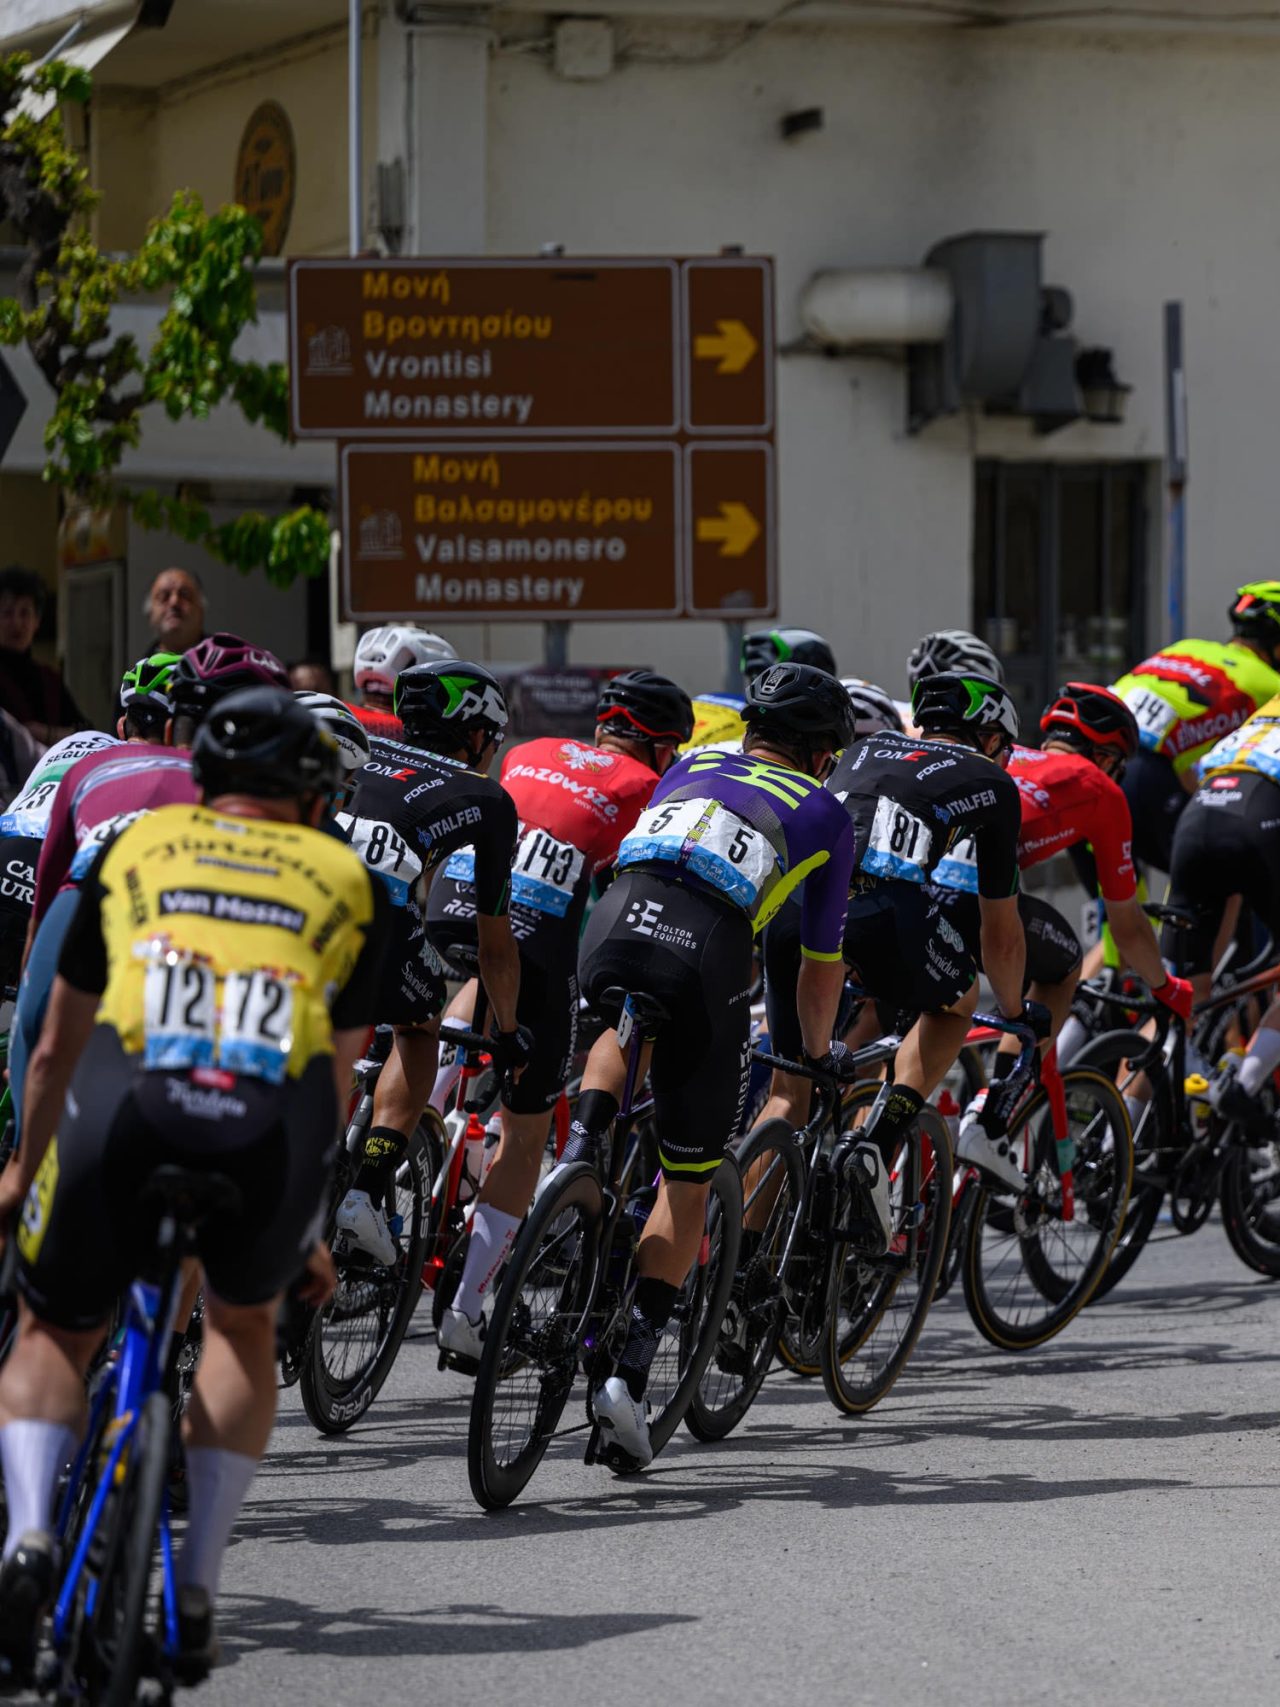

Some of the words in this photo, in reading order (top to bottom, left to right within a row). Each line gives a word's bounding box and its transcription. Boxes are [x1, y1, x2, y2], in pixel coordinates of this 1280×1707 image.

[362, 271, 450, 304] Μονή
[363, 309, 552, 343] Βροντησίου
[365, 350, 492, 379] Vrontisi
[364, 391, 534, 424] Monastery
[413, 454, 500, 488] Μονή
[414, 492, 653, 526] Βαλσαμονέρου
[416, 535, 627, 564] Valsamonero
[416, 573, 584, 606] Monastery
[916, 758, 957, 781] FOCUS
[403, 778, 445, 804] FOCUS
[946, 789, 997, 816] ITALFER
[428, 806, 482, 840] ITALFER
[648, 806, 682, 835] 5
[727, 828, 753, 864] 5
[890, 811, 920, 858] 81
[365, 825, 406, 872] 84
[522, 832, 575, 886] 143
[162, 890, 211, 914] Van
[653, 930, 697, 950] EQUITIES
[656, 923, 693, 939] BOLTON
[158, 963, 206, 1029] 72
[237, 975, 284, 1041] 72
[723, 1070, 749, 1151] EQUITIES
[415, 1146, 430, 1240] URSUS
[329, 1386, 372, 1422] URSUS
